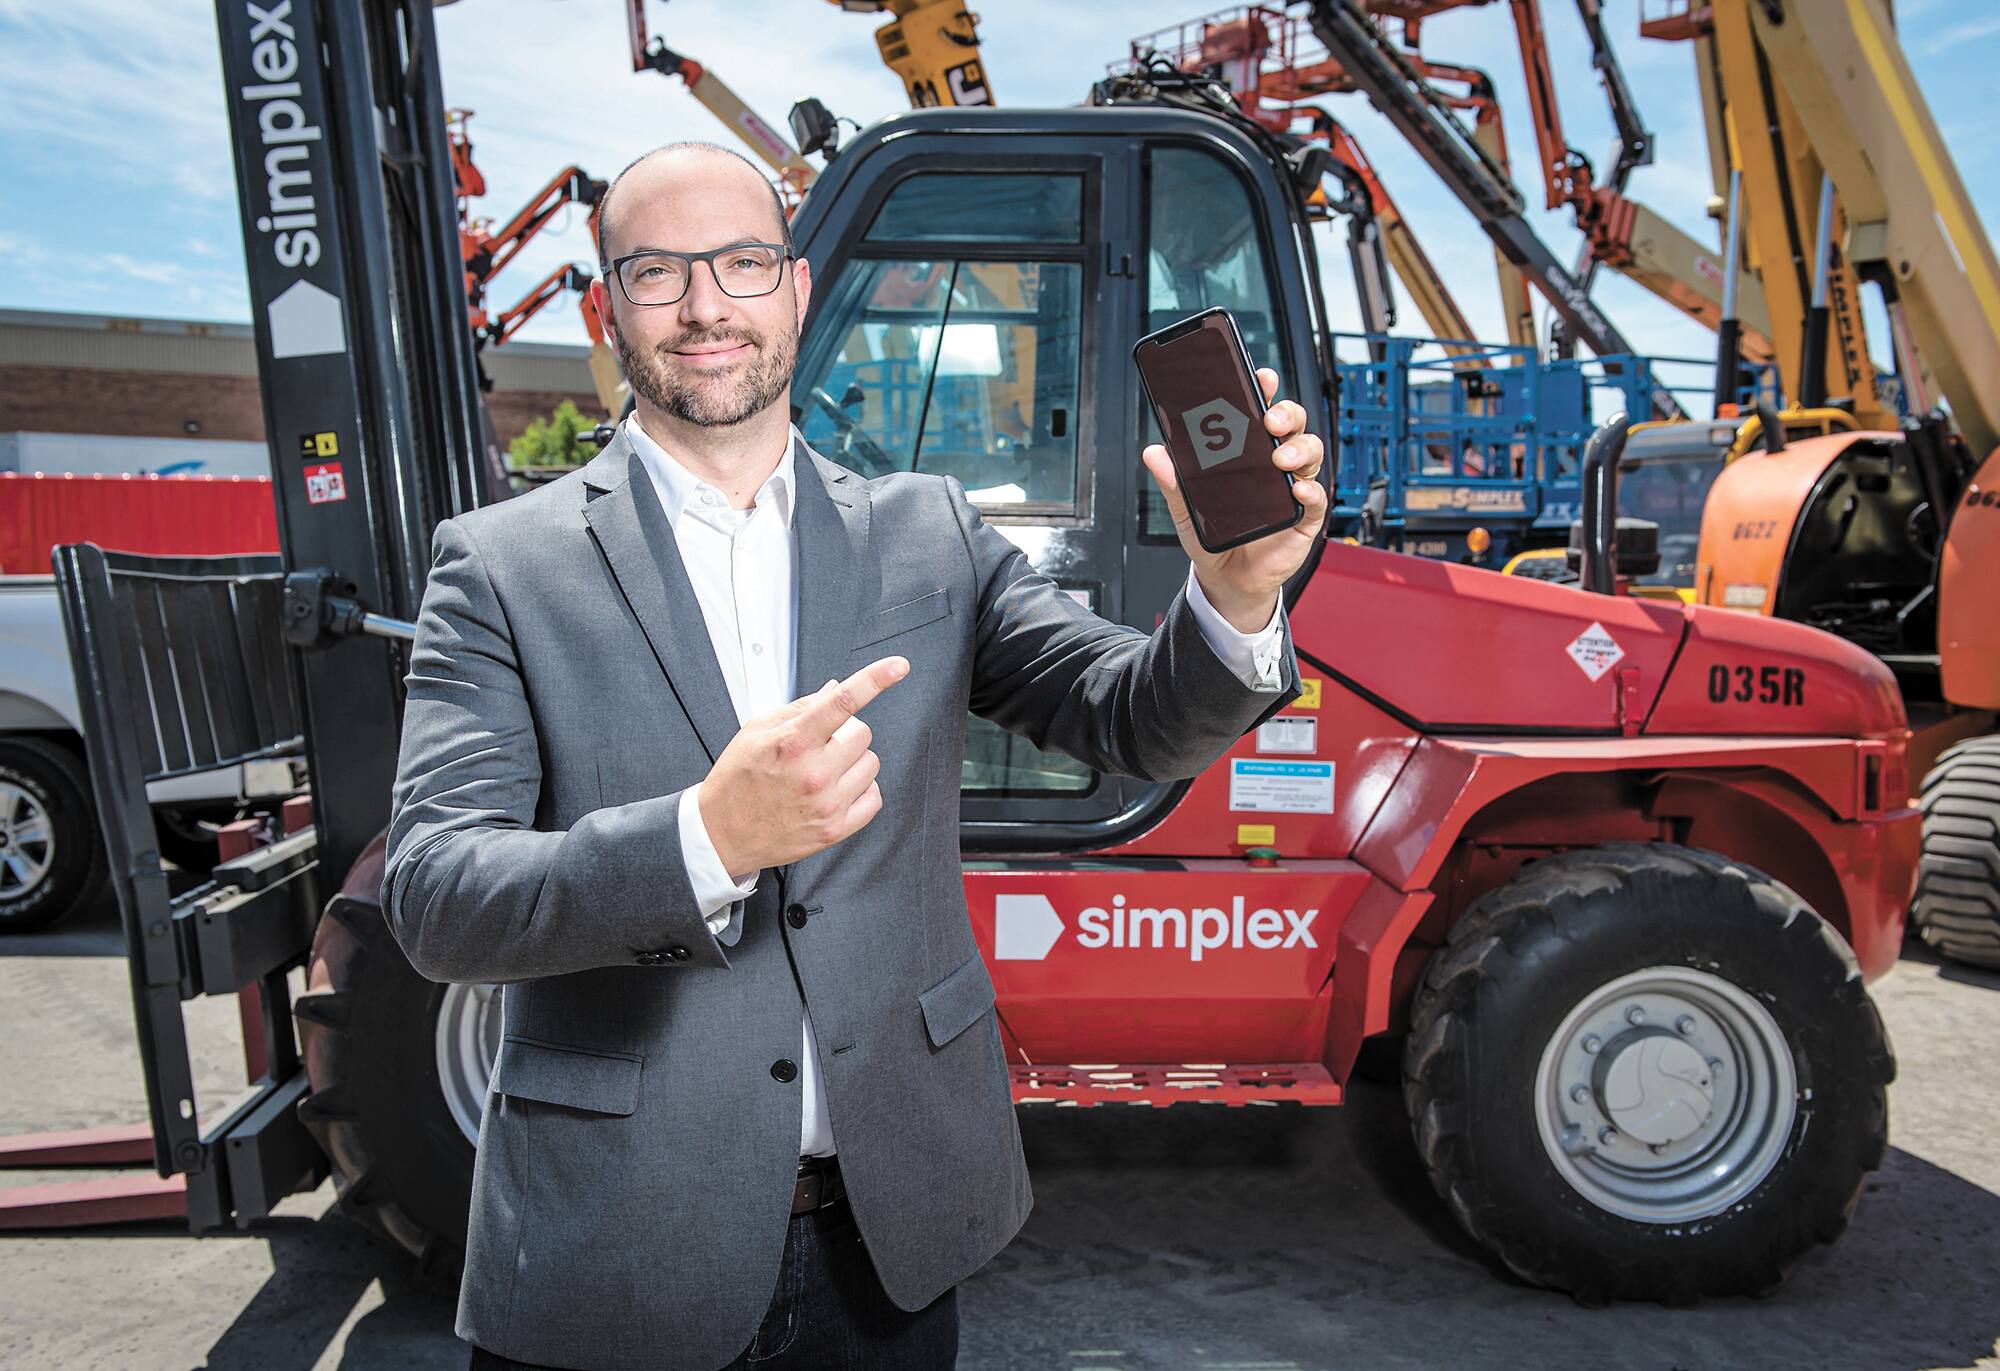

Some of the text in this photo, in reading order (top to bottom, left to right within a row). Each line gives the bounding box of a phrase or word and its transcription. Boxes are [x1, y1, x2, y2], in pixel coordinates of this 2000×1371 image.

[241, 0, 322, 268] simplex
[1200, 413, 1232, 451] S
[1708, 664, 1805, 706] 035R
[1077, 893, 1319, 961] simplex
